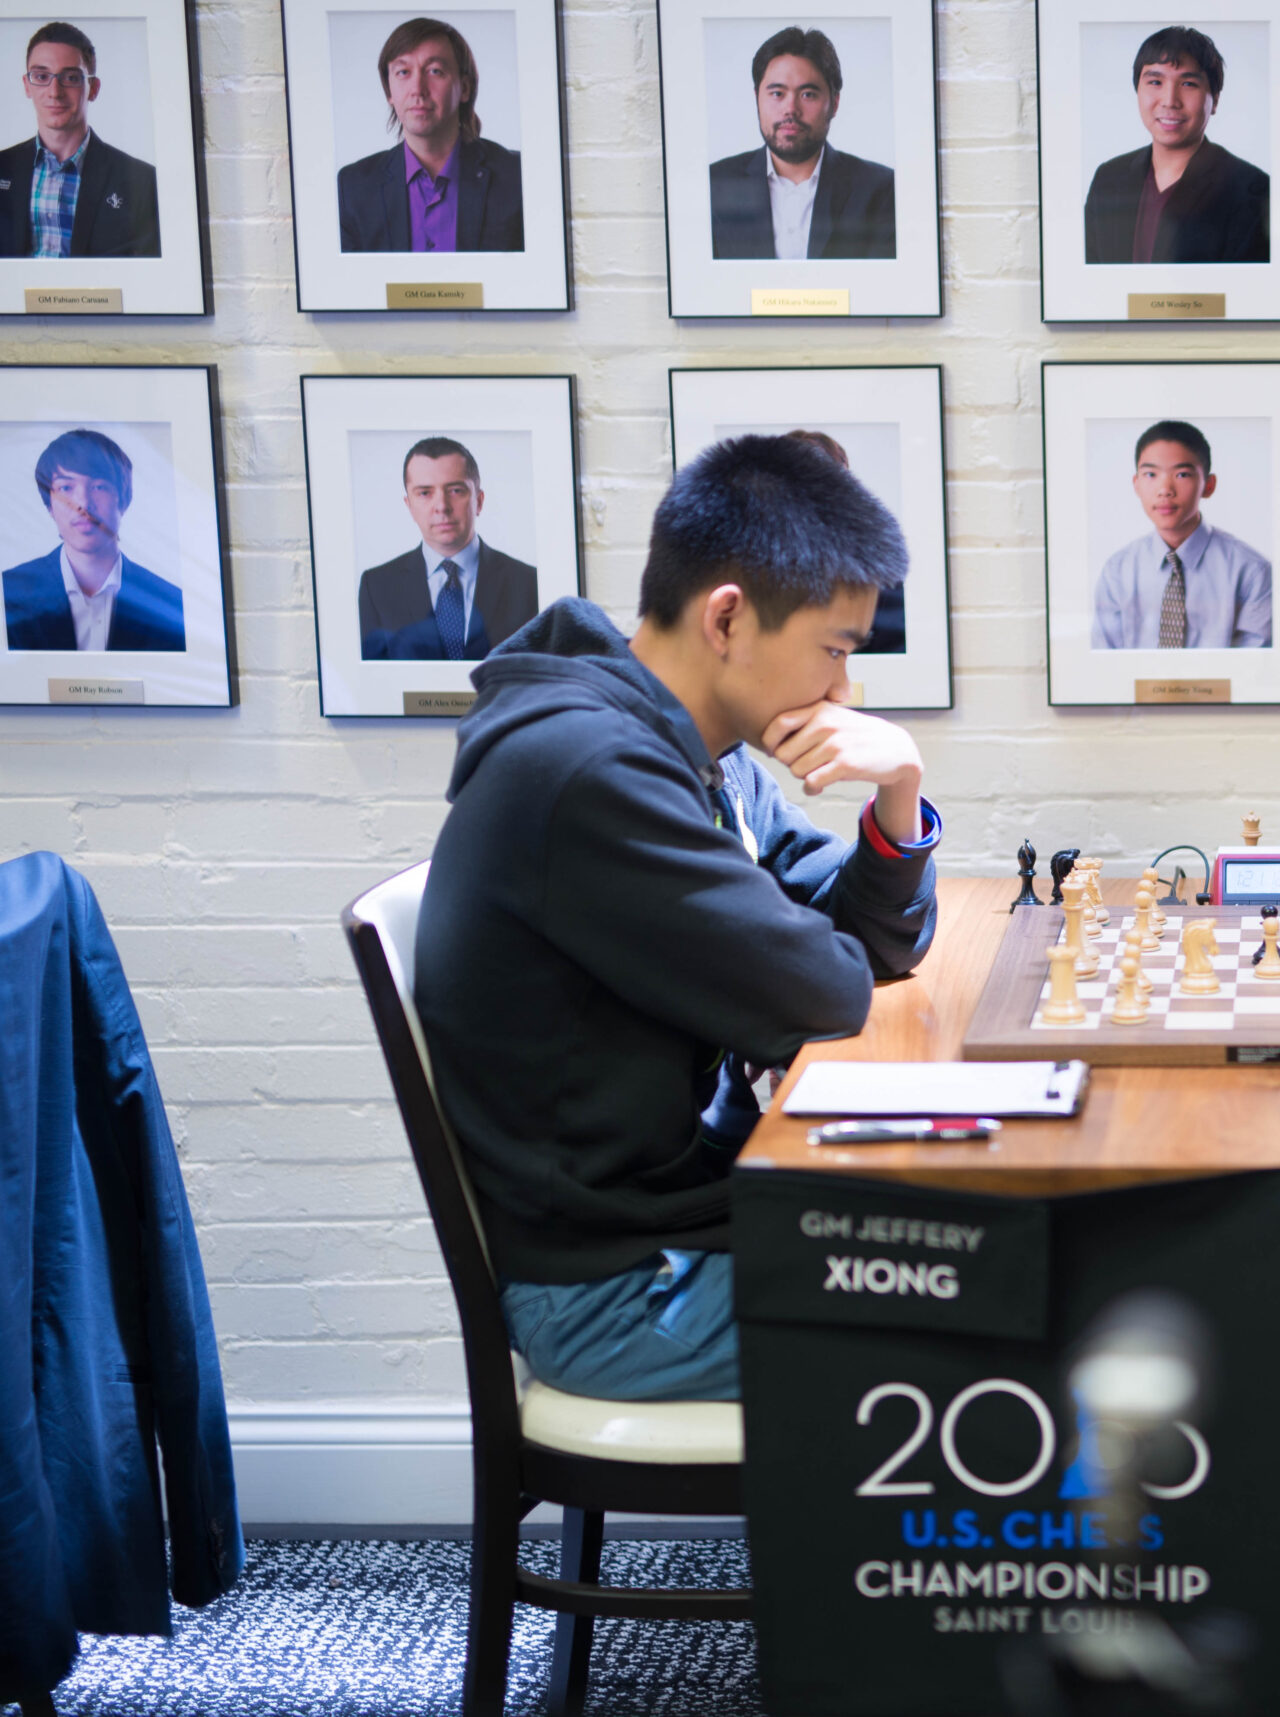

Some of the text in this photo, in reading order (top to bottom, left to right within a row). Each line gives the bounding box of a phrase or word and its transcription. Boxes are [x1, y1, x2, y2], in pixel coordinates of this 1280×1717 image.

[404, 289, 465, 299] GM Gata Kamsky
[1151, 300, 1203, 310] GM Wesley So
[69, 686, 123, 696] GM Ray Robson
[1152, 686, 1165, 694] GM
[1167, 686, 1190, 696] Jeffery
[418, 699, 432, 708] GM
[800, 1211, 984, 1252] GM JEFFERY
[824, 1256, 959, 1299] XIONG
[901, 1510, 1165, 1551] U.S. CHES
[855, 1560, 1211, 1603] CHAMPIONSHIP
[934, 1606, 1031, 1633] SAINT
